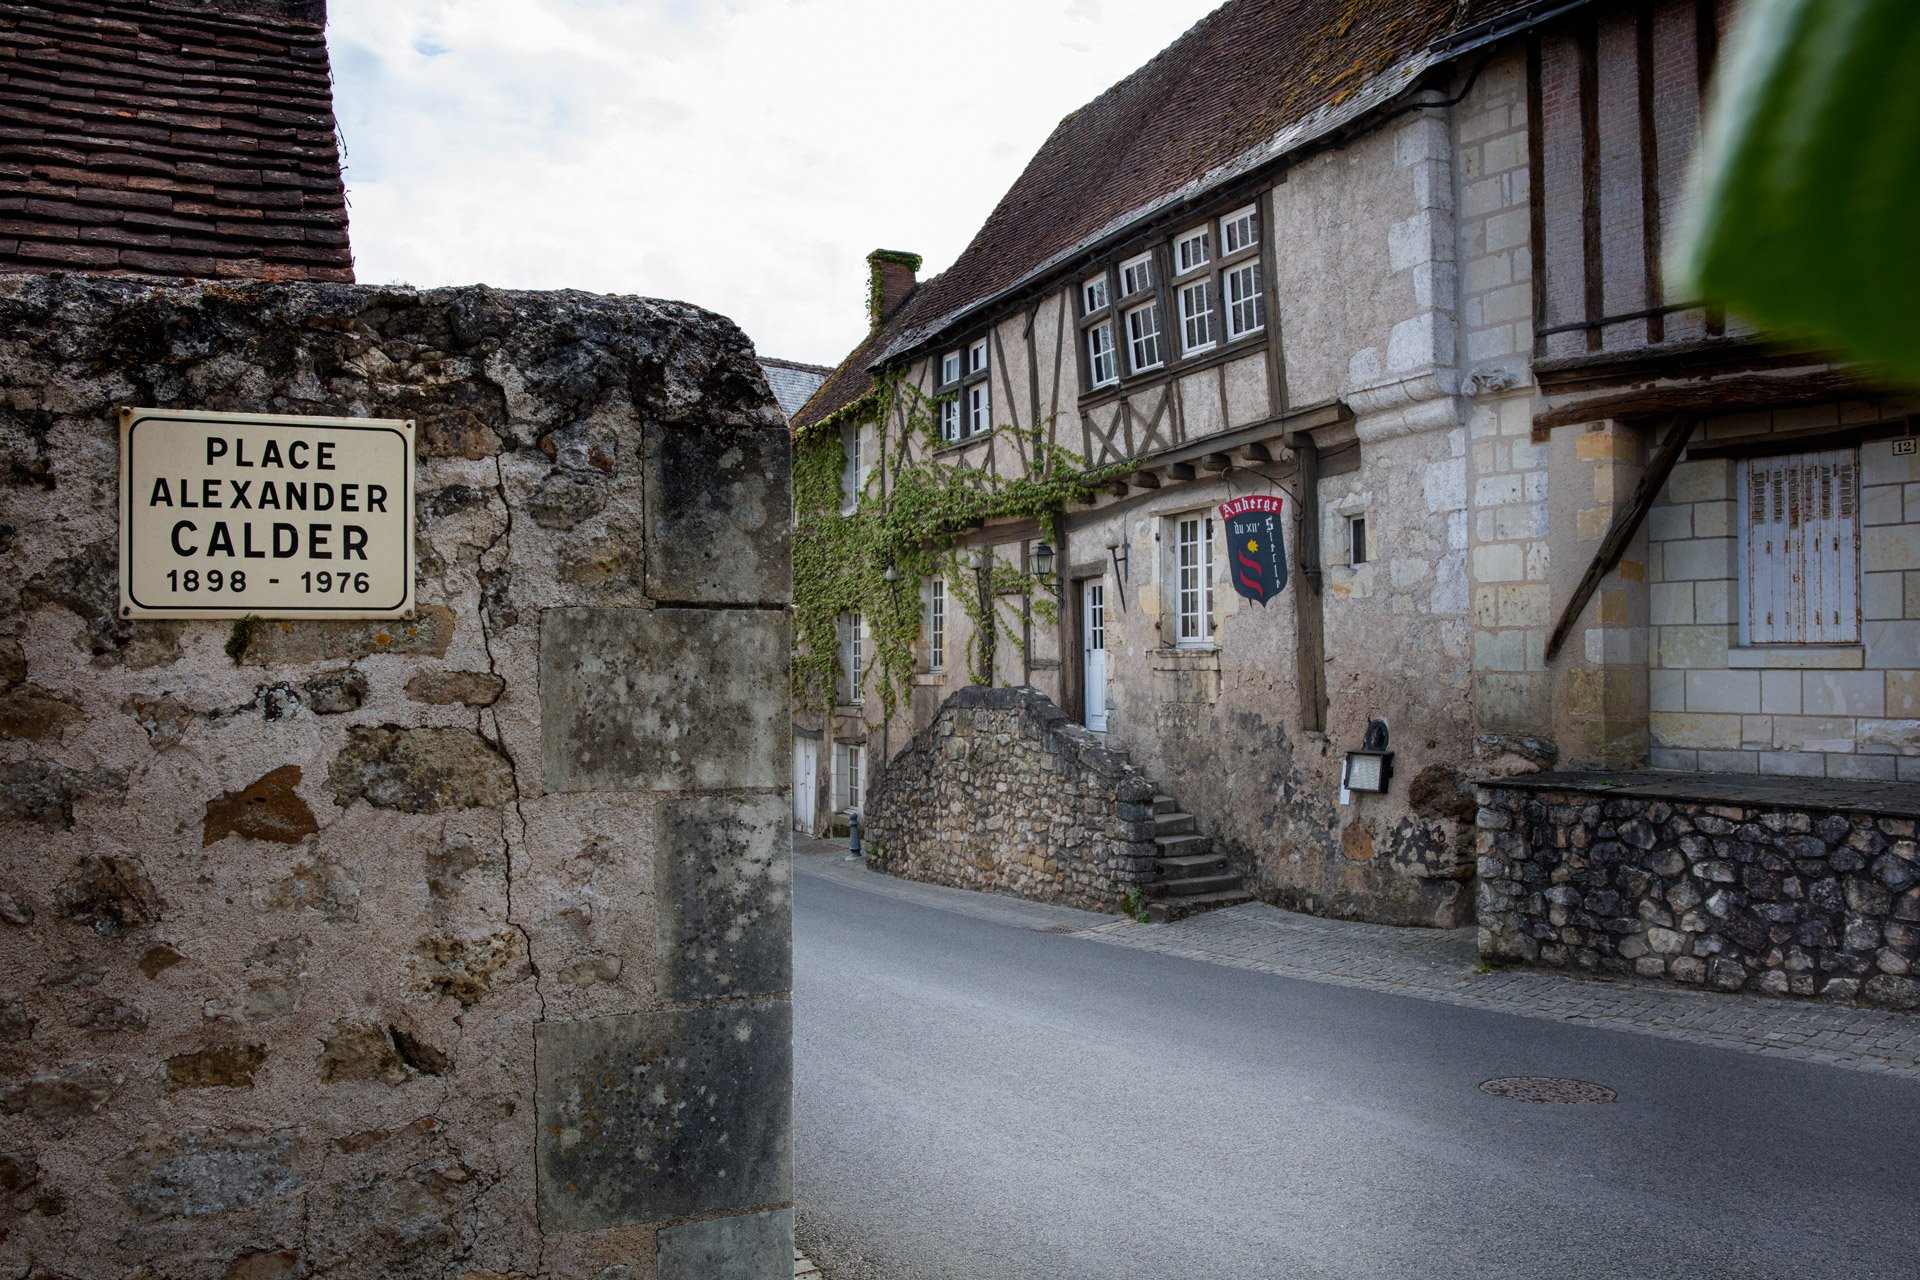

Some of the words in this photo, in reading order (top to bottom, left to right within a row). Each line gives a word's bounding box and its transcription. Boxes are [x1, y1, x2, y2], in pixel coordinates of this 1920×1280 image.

[206, 436, 336, 471] PLACE
[1897, 441, 1911, 453] 12
[149, 477, 388, 513] ALEXANDER
[1222, 497, 1278, 518] Auberge
[170, 519, 369, 561] CALDER
[1233, 521, 1244, 535] du
[166, 569, 247, 593] 1898
[301, 571, 370, 594] 1976
